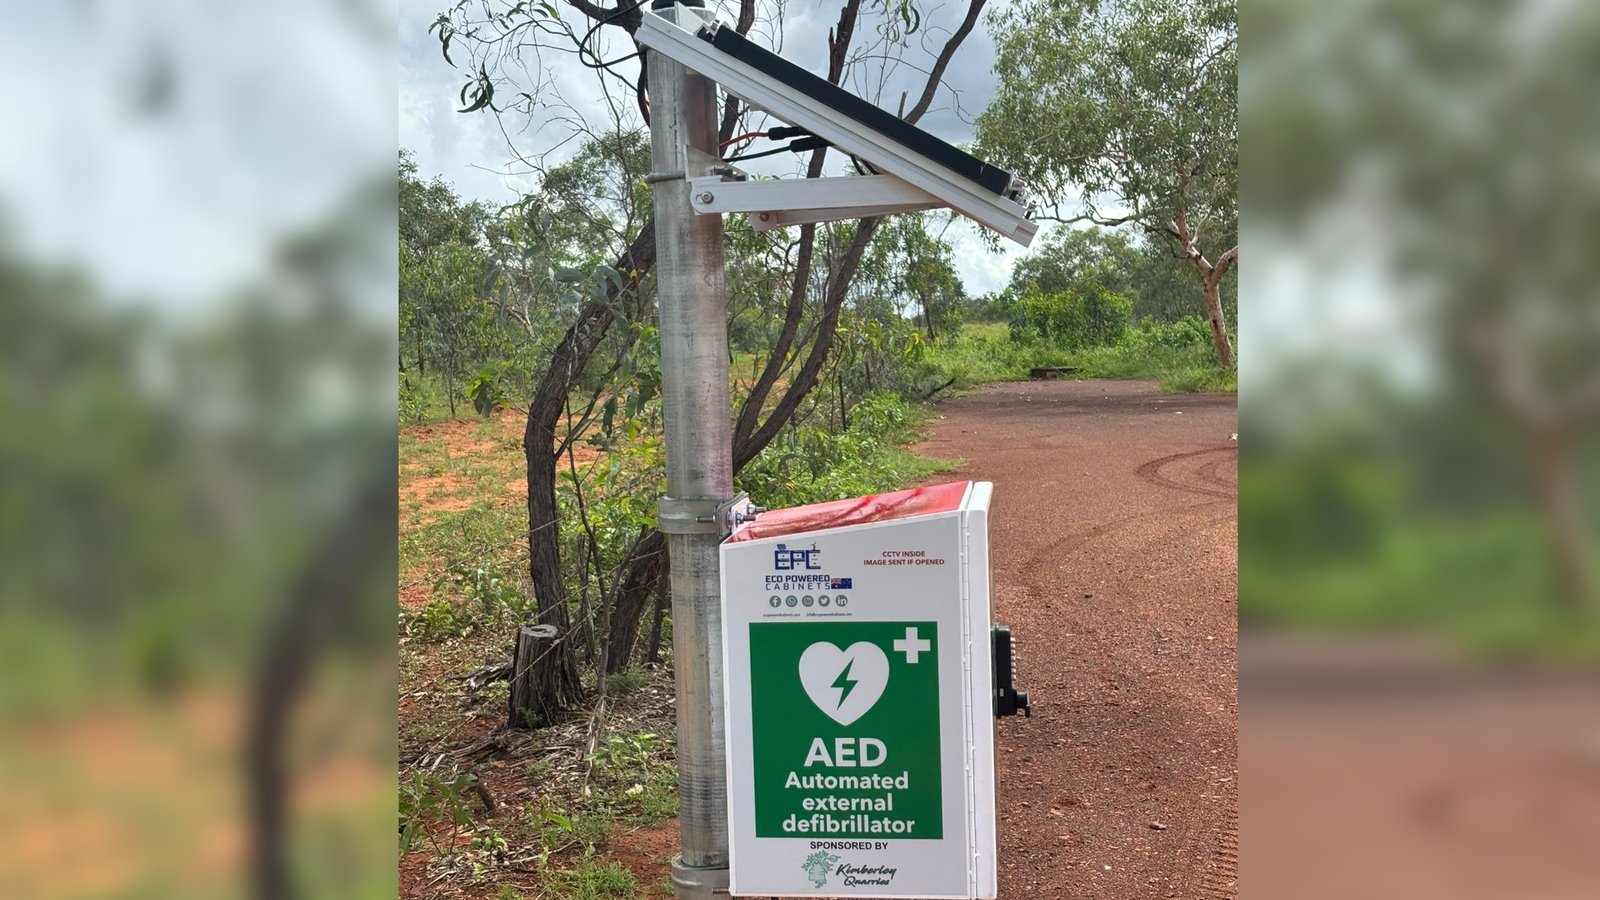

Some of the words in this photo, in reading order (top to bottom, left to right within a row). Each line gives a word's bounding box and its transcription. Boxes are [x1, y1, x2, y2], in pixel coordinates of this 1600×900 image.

[765, 575, 783, 583] ECO
[785, 574, 830, 582] POWERED
[765, 582, 831, 590] CABINETS
[803, 737, 888, 767] AED
[784, 770, 909, 789] Automated
[802, 792, 893, 811] external
[782, 813, 915, 833] defibrillator
[810, 841, 872, 850] SPONSORED
[875, 842, 889, 850] BY
[835, 863, 897, 880] Kimberley
[843, 875, 890, 888] Quarries
